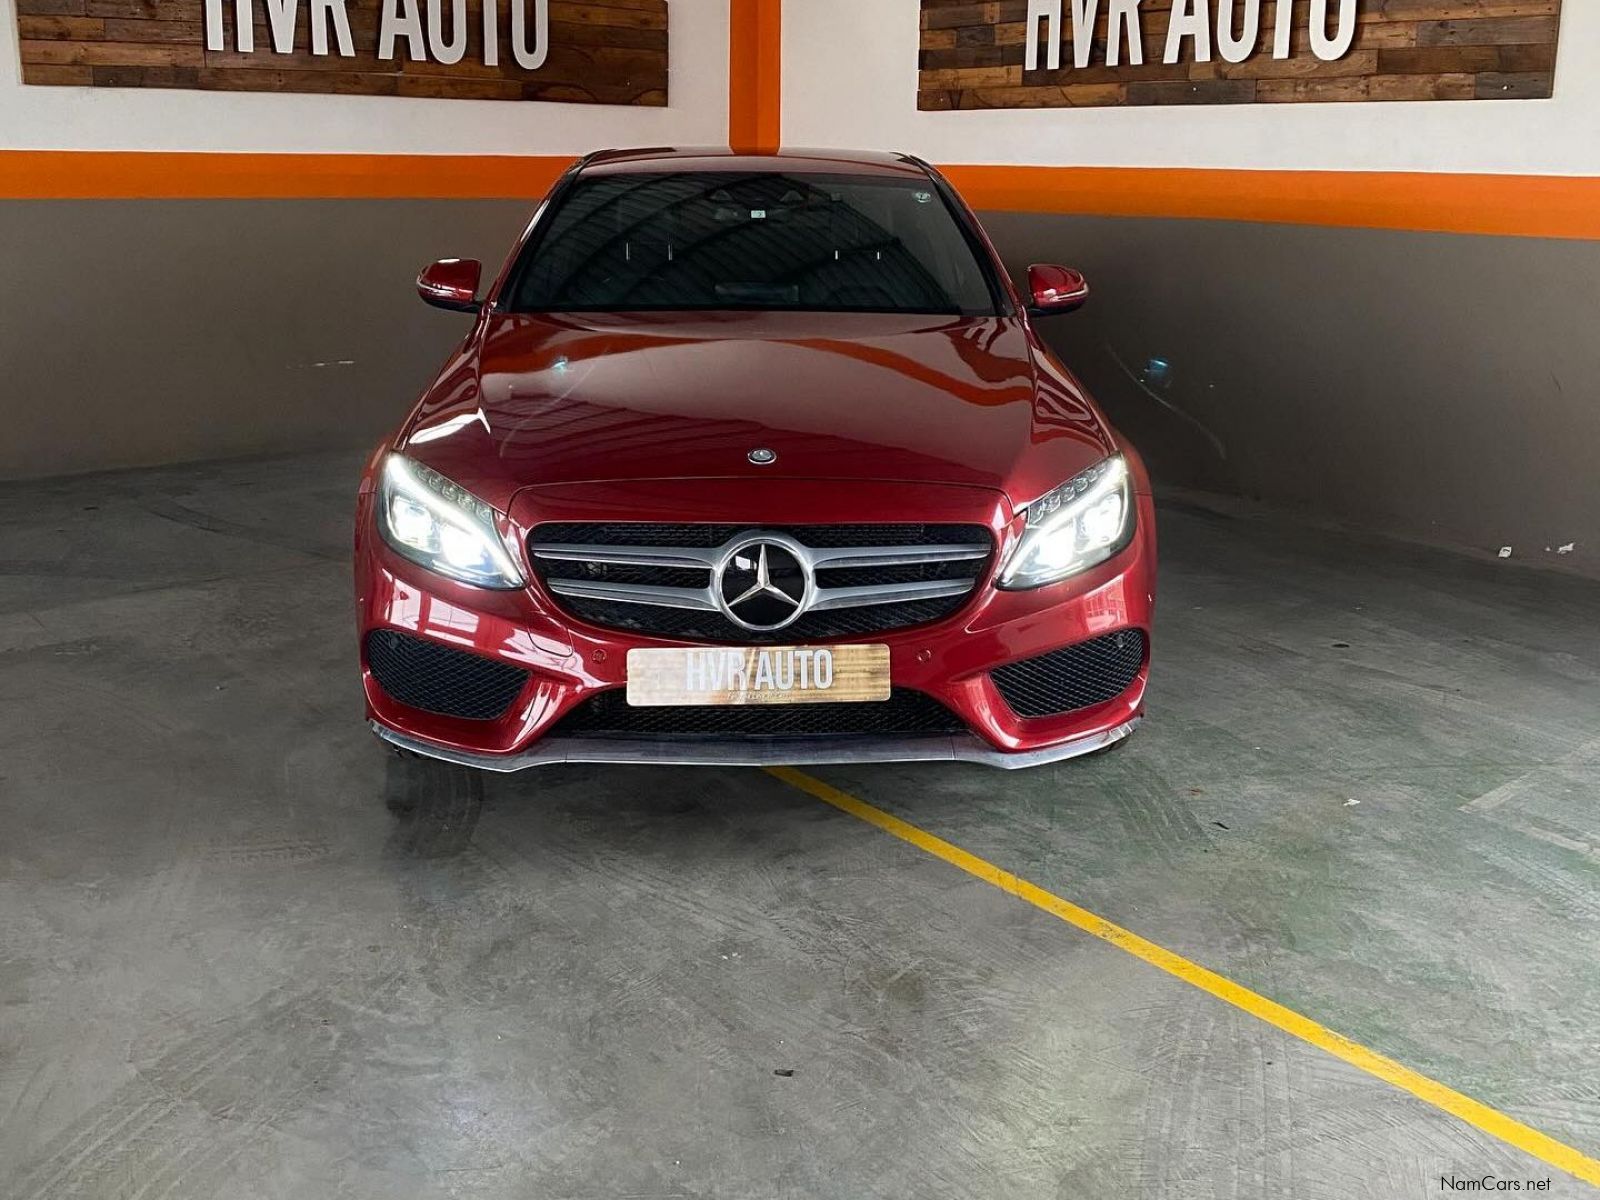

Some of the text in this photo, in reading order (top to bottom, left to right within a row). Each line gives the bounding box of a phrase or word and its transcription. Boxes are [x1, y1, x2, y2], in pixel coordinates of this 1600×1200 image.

[1025, 0, 1143, 71] HVR
[686, 649, 834, 691] HVR AUTO
